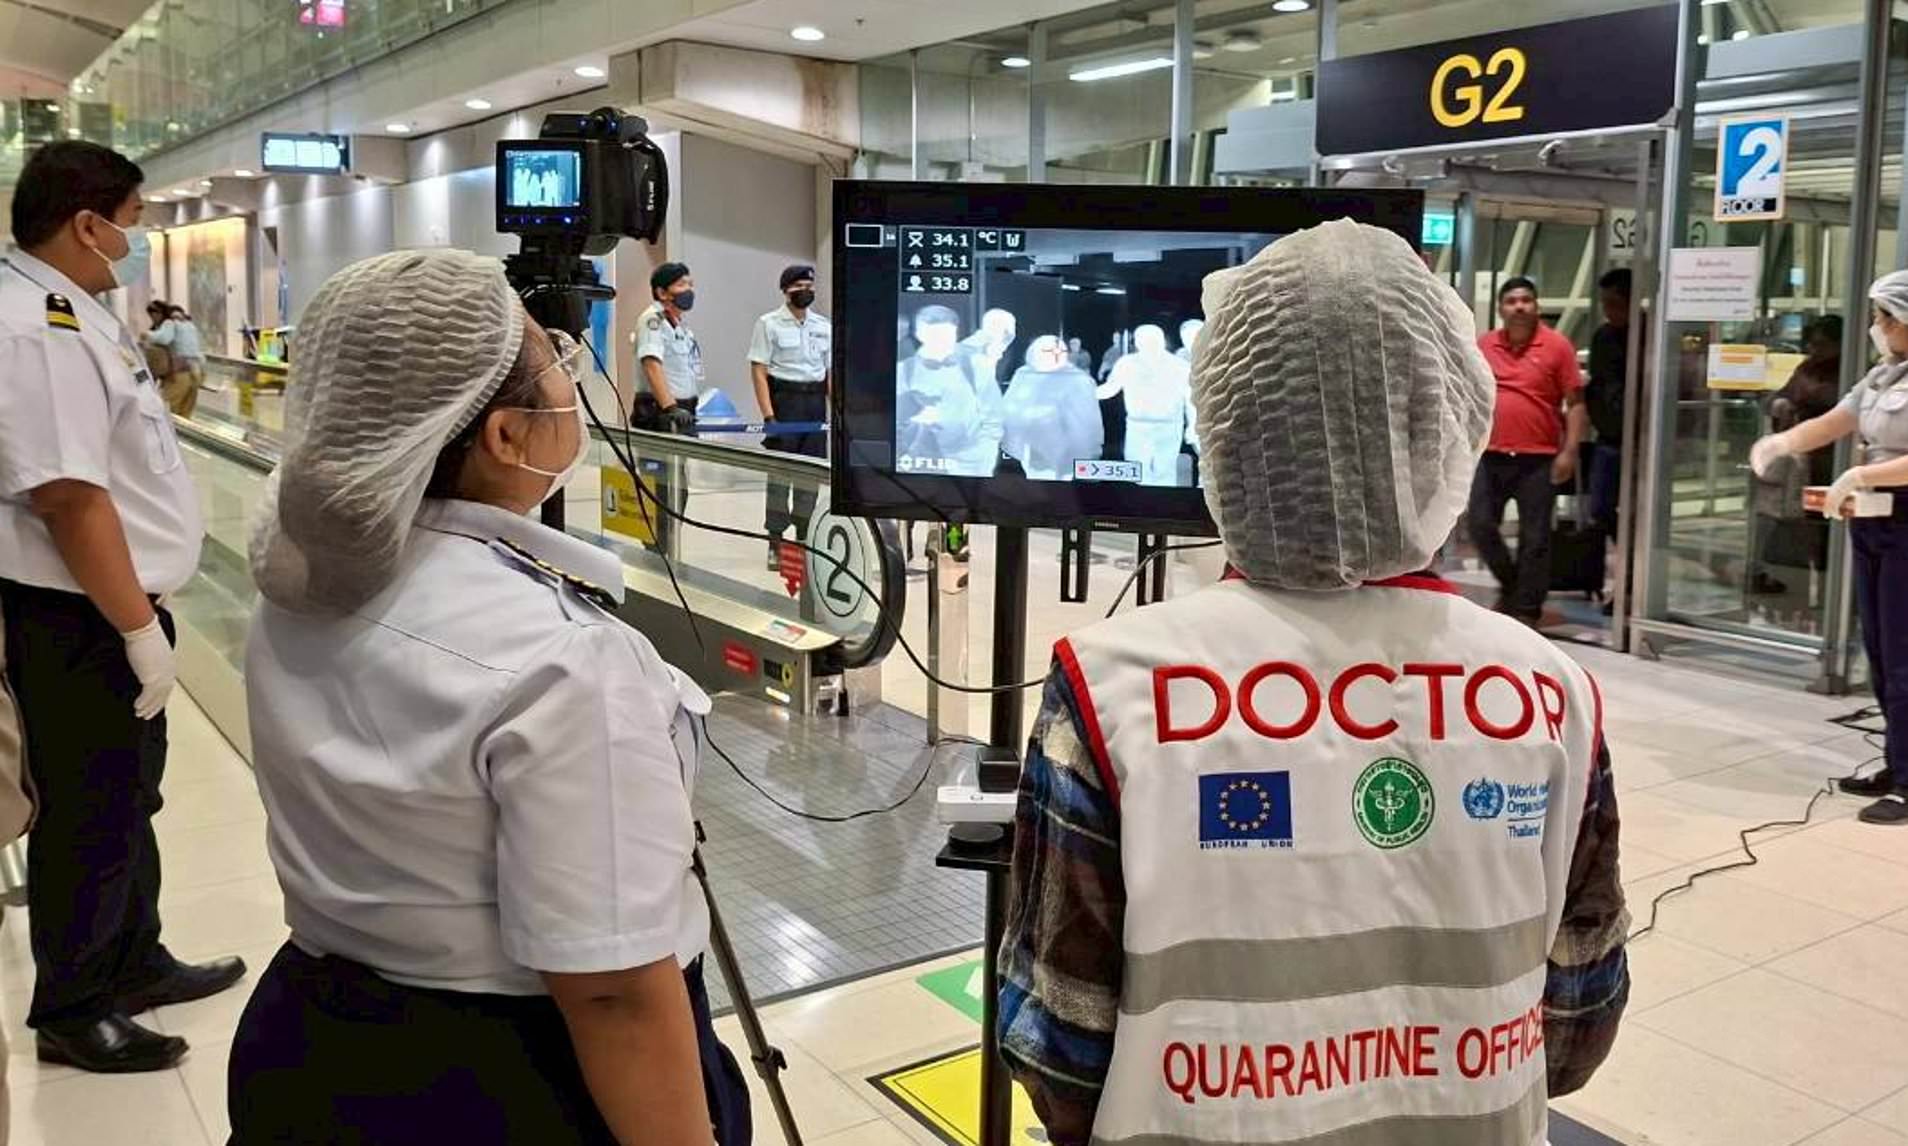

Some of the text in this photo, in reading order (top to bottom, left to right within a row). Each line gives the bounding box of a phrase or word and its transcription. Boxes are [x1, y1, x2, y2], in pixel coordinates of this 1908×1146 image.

[1430, 47, 1526, 127] G2
[1736, 126, 1782, 198] 2
[932, 233, 969, 247] 34.1
[932, 254, 969, 268] 35.1
[931, 277, 969, 291] 33.8
[1105, 465, 1139, 478] 35.1
[827, 525, 852, 602] 2
[1152, 660, 1567, 743] DOCTOR
[1162, 1025, 1440, 1104] QUARANTINE
